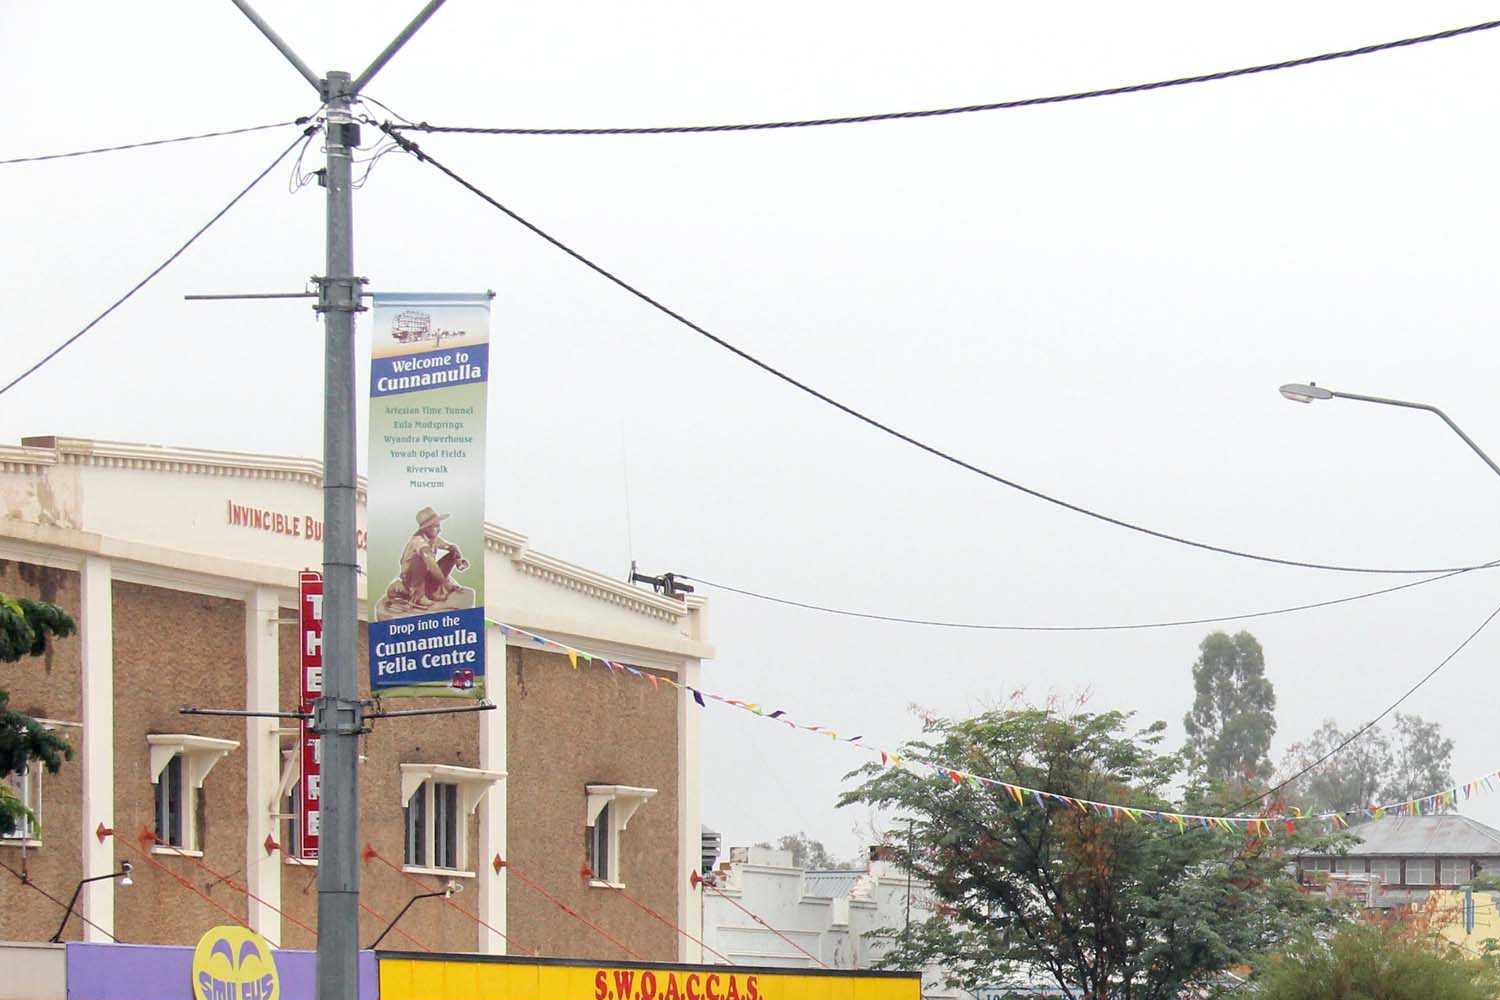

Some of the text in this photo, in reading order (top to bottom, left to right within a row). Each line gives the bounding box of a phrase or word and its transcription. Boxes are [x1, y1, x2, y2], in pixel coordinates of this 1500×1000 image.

[392, 352, 469, 373] Welcome to
[377, 364, 482, 392] Cunnamulla
[422, 405, 442, 415] Time
[445, 405, 474, 415] Tunnel
[423, 434, 473, 443] Powerhouse
[419, 449, 439, 459] Opal
[441, 449, 466, 458] Fields
[406, 464, 449, 473] Riverwalk
[409, 480, 445, 488] Museum
[389, 616, 460, 636] Drop into the
[376, 629, 478, 657] Cunnamulla
[378, 650, 476, 676] Fella Centre
[306, 593, 323, 837] THETRE
